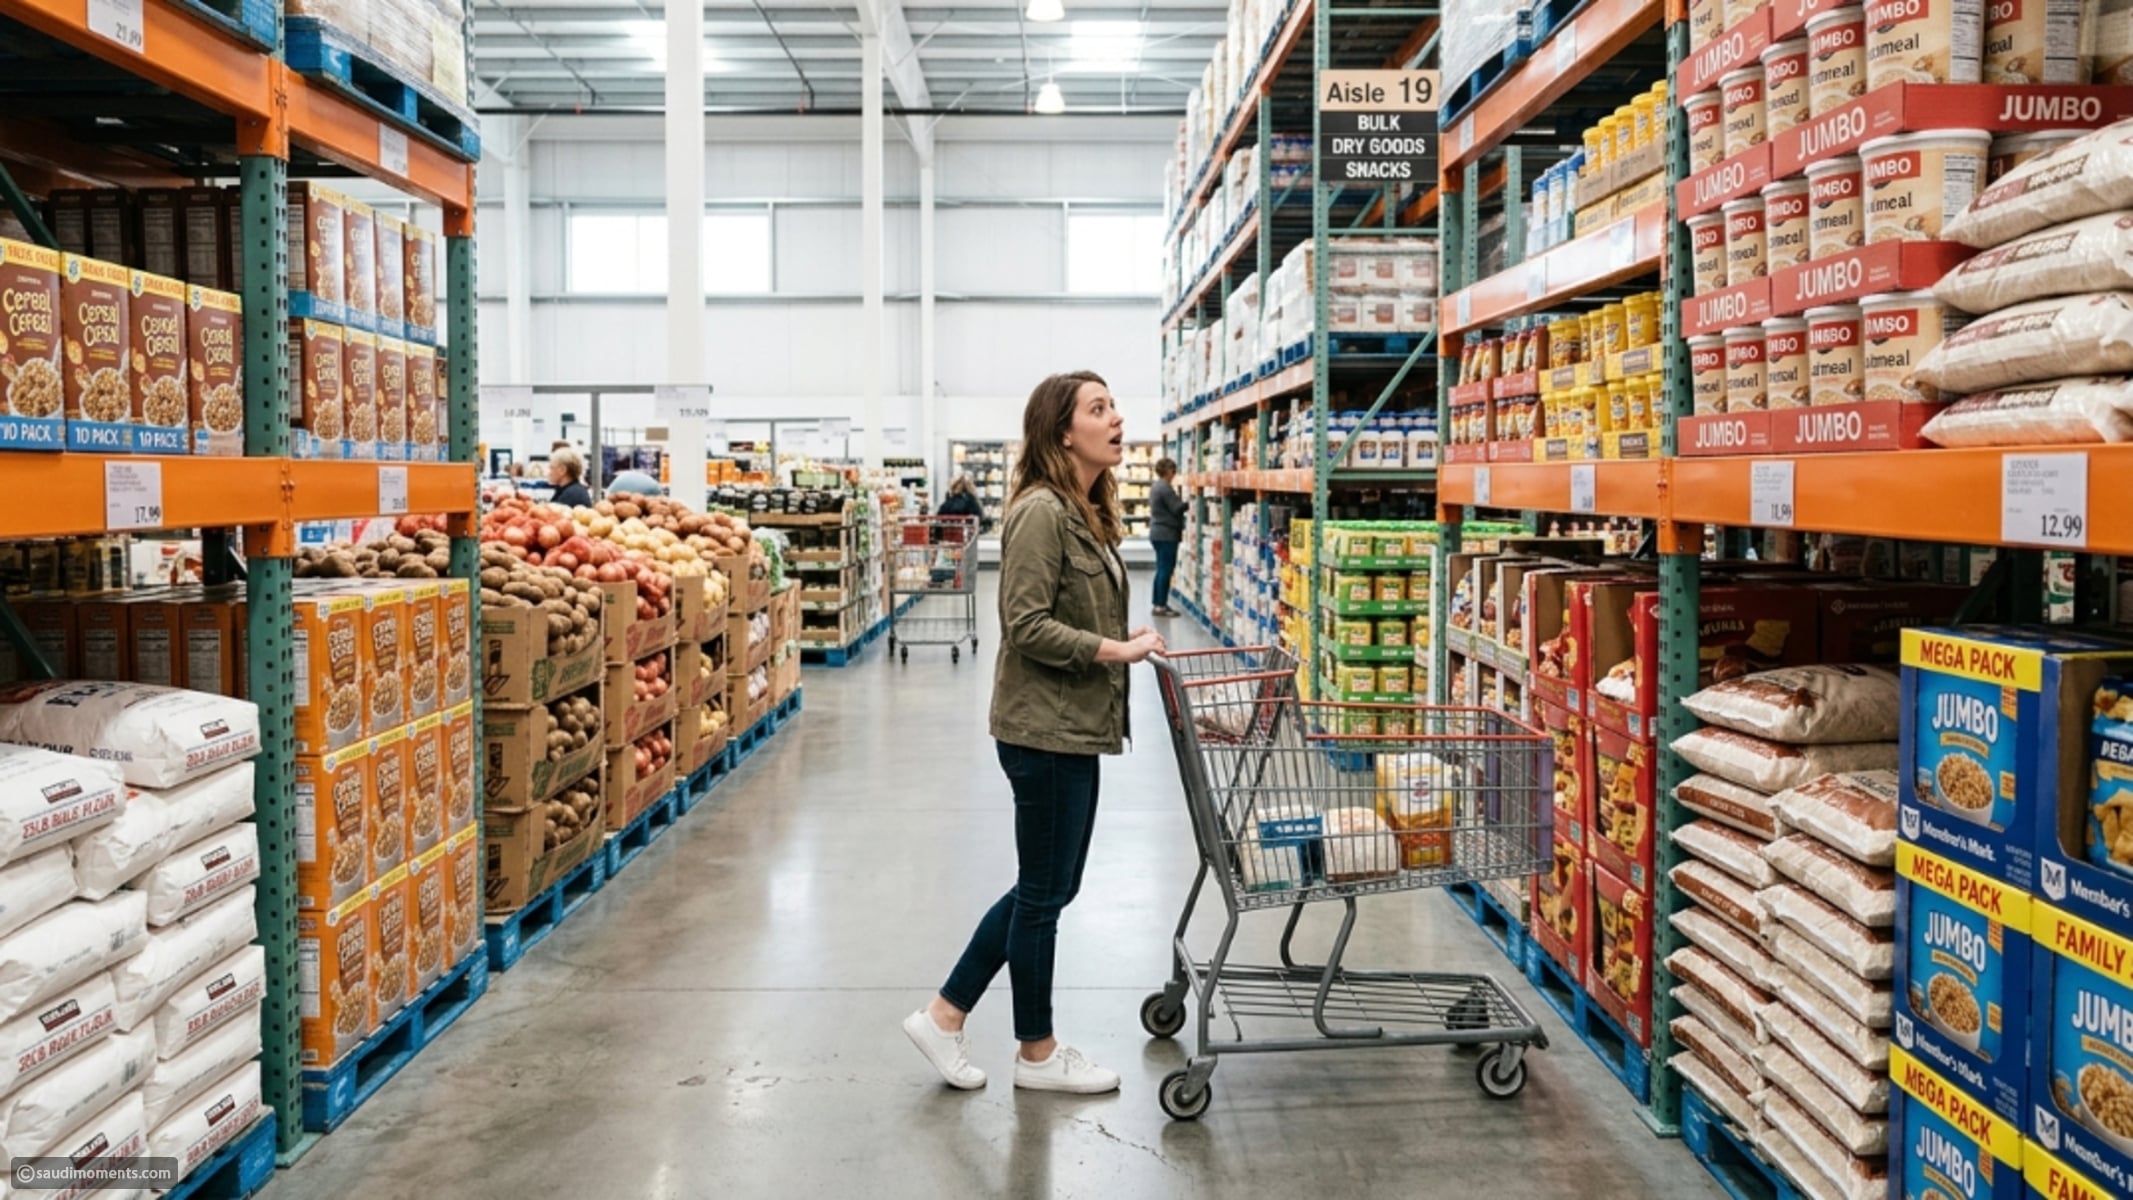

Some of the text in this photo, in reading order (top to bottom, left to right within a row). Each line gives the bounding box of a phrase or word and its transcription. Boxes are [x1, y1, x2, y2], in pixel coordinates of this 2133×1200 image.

[1693, 32, 1744, 86] JUMBO
[1326, 77, 1433, 104] Aisle 19
[1999, 95, 2101, 121] JUMBO
[1357, 114, 1401, 131] BULK
[1798, 106, 1866, 160] JUMBO
[1332, 138, 1426, 154] DRY GOODS
[1346, 161, 1411, 178] SNACKS
[1694, 162, 1744, 206] JUMBO
[1796, 258, 1862, 300] JUMBO
[1696, 292, 1747, 328] JUMBO
[21, 425, 52, 442] PACK
[1696, 420, 1747, 448] JUMBO
[1795, 411, 1861, 443] JUMBO
[2041, 514, 2082, 538] 12.99
[1920, 639, 2016, 680] MEGA PACK
[1932, 692, 1998, 743] JUMBO
[1912, 854, 1955, 894] MEGA
[1959, 874, 2003, 916] PACK
[1924, 911, 1986, 973] JUMBO
[2056, 919, 2127, 975] FAMILY
[1904, 1062, 1946, 1102] MEGA
[1950, 1095, 1992, 1146] PACK
[1916, 1125, 1975, 1198] JUMBO
